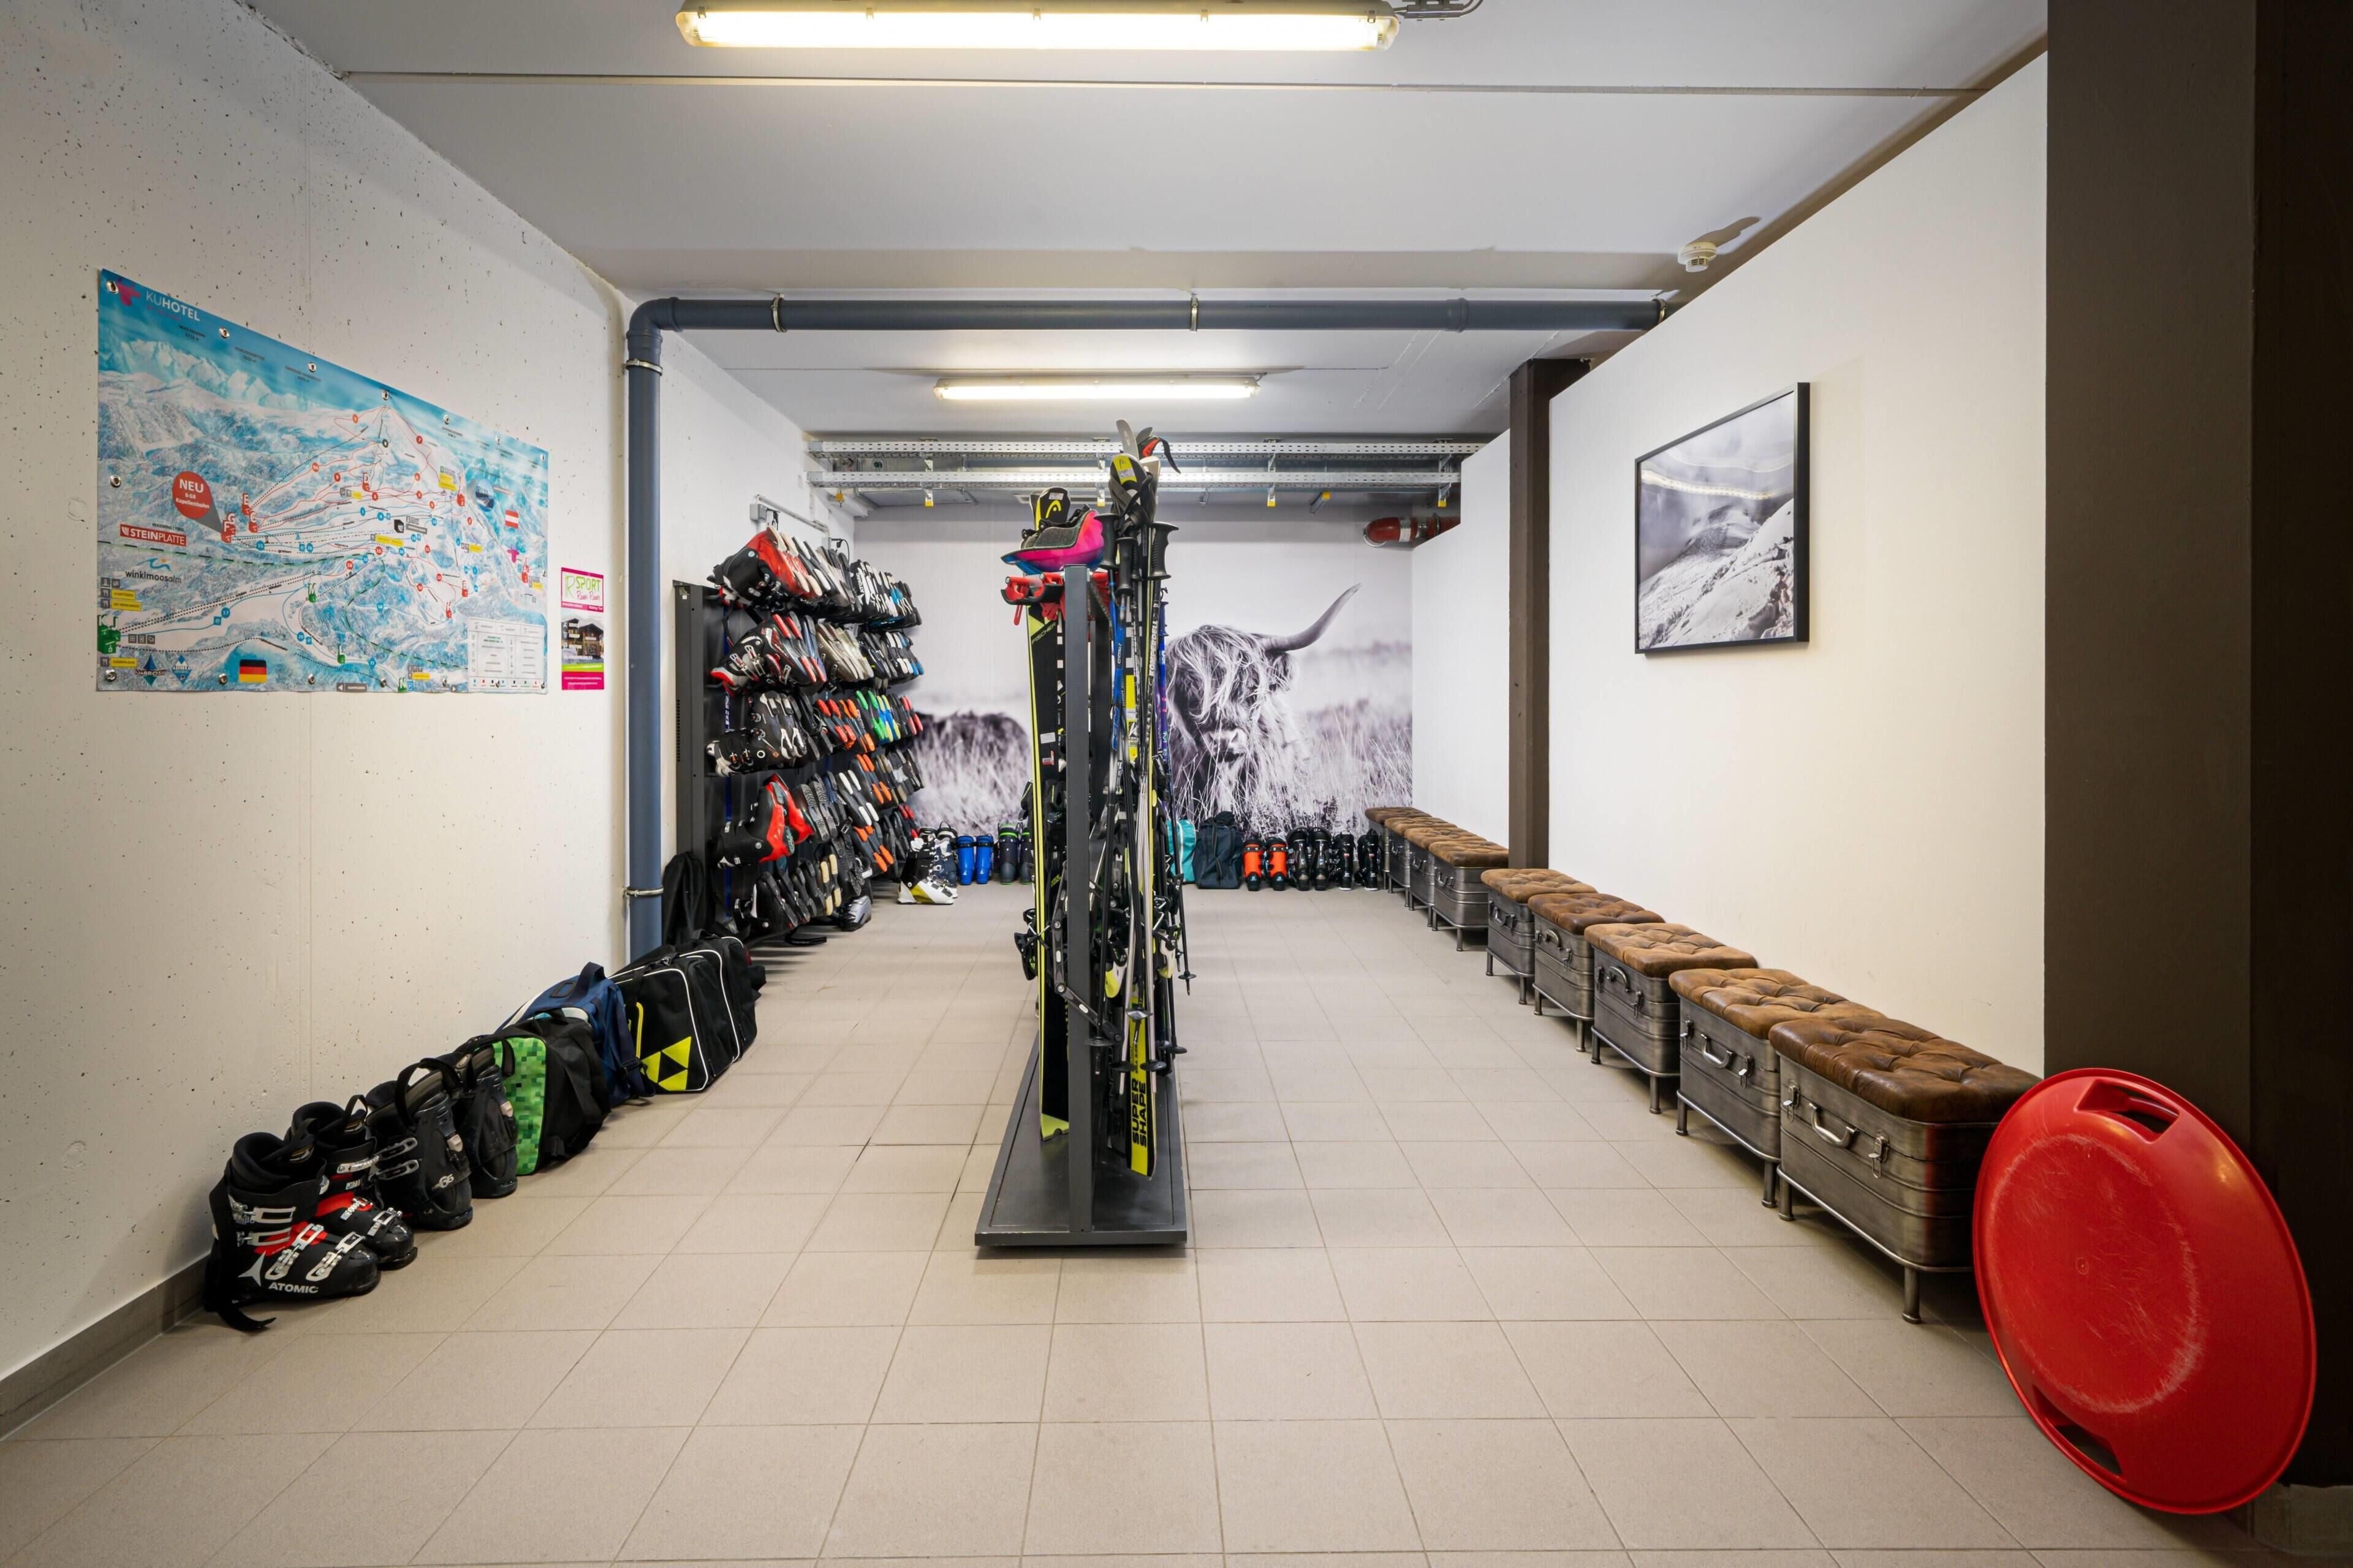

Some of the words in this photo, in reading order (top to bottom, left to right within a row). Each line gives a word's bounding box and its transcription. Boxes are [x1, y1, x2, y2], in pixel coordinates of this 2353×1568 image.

[146, 291, 200, 321] KUHOTEL
[180, 479, 203, 493] NEU
[244, 494, 249, 504] E
[228, 513, 235, 524] G
[250, 512, 257, 522] C
[224, 521, 230, 531] F
[131, 529, 184, 545] STEINPLATTE
[125, 570, 182, 583] winklmoosalm
[576, 576, 601, 592] SPORT
[99, 615, 107, 626] K
[1148, 619, 1158, 677] KOMPERDELL
[268, 1282, 317, 1293] ATOMIC
